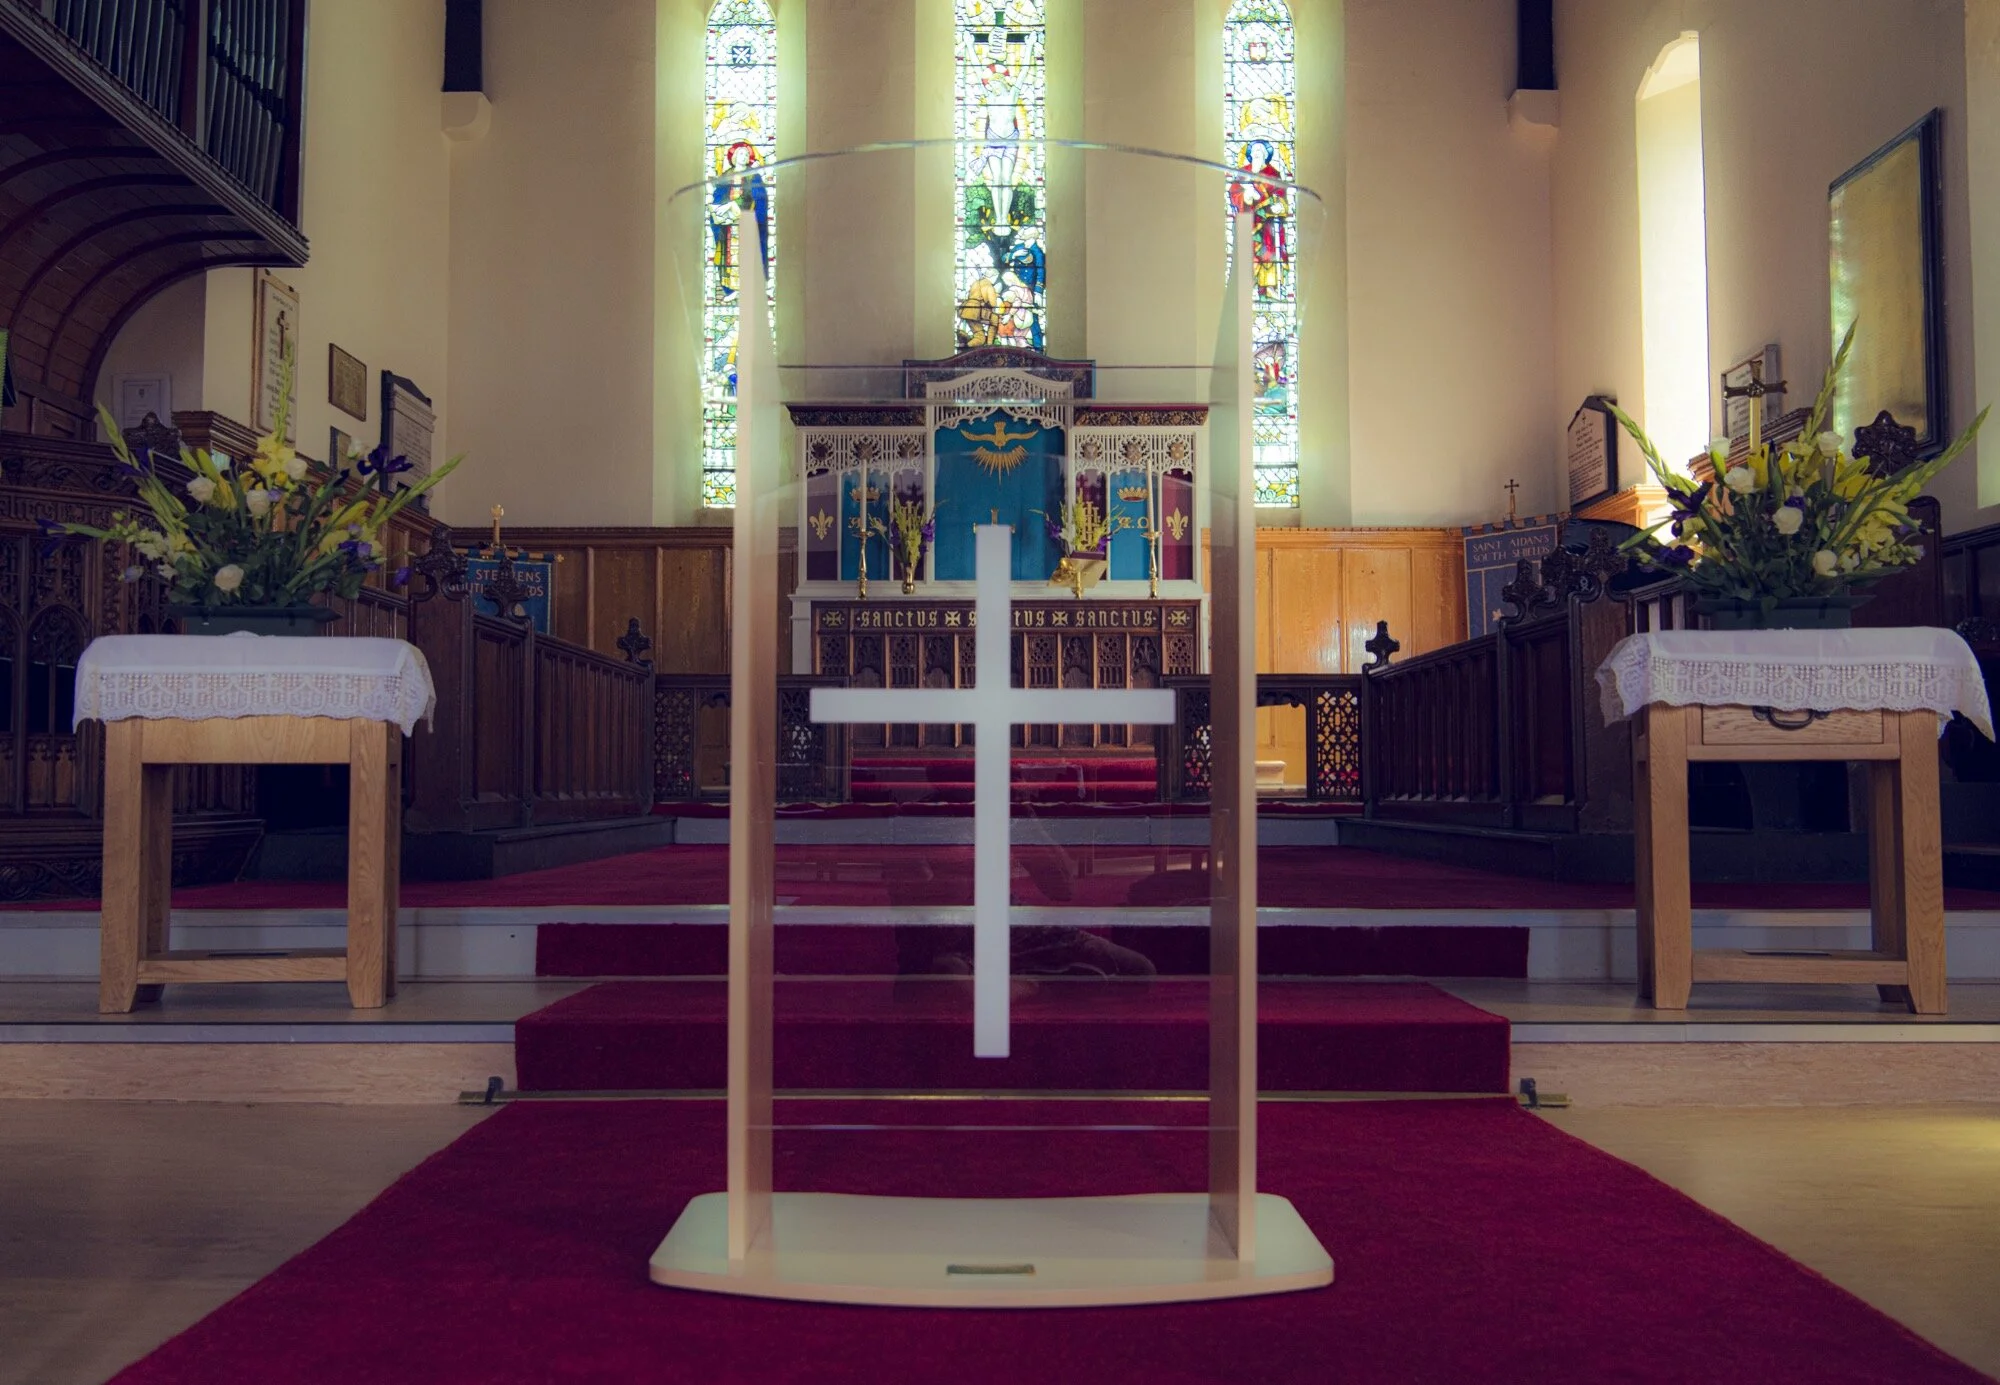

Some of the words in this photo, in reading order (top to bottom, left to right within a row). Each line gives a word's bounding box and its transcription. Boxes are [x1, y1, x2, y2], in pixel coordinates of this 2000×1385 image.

[1472, 540, 1502, 553] SAINT
[1472, 551, 1507, 562] SOUTH
[476, 569, 542, 583] STEENS
